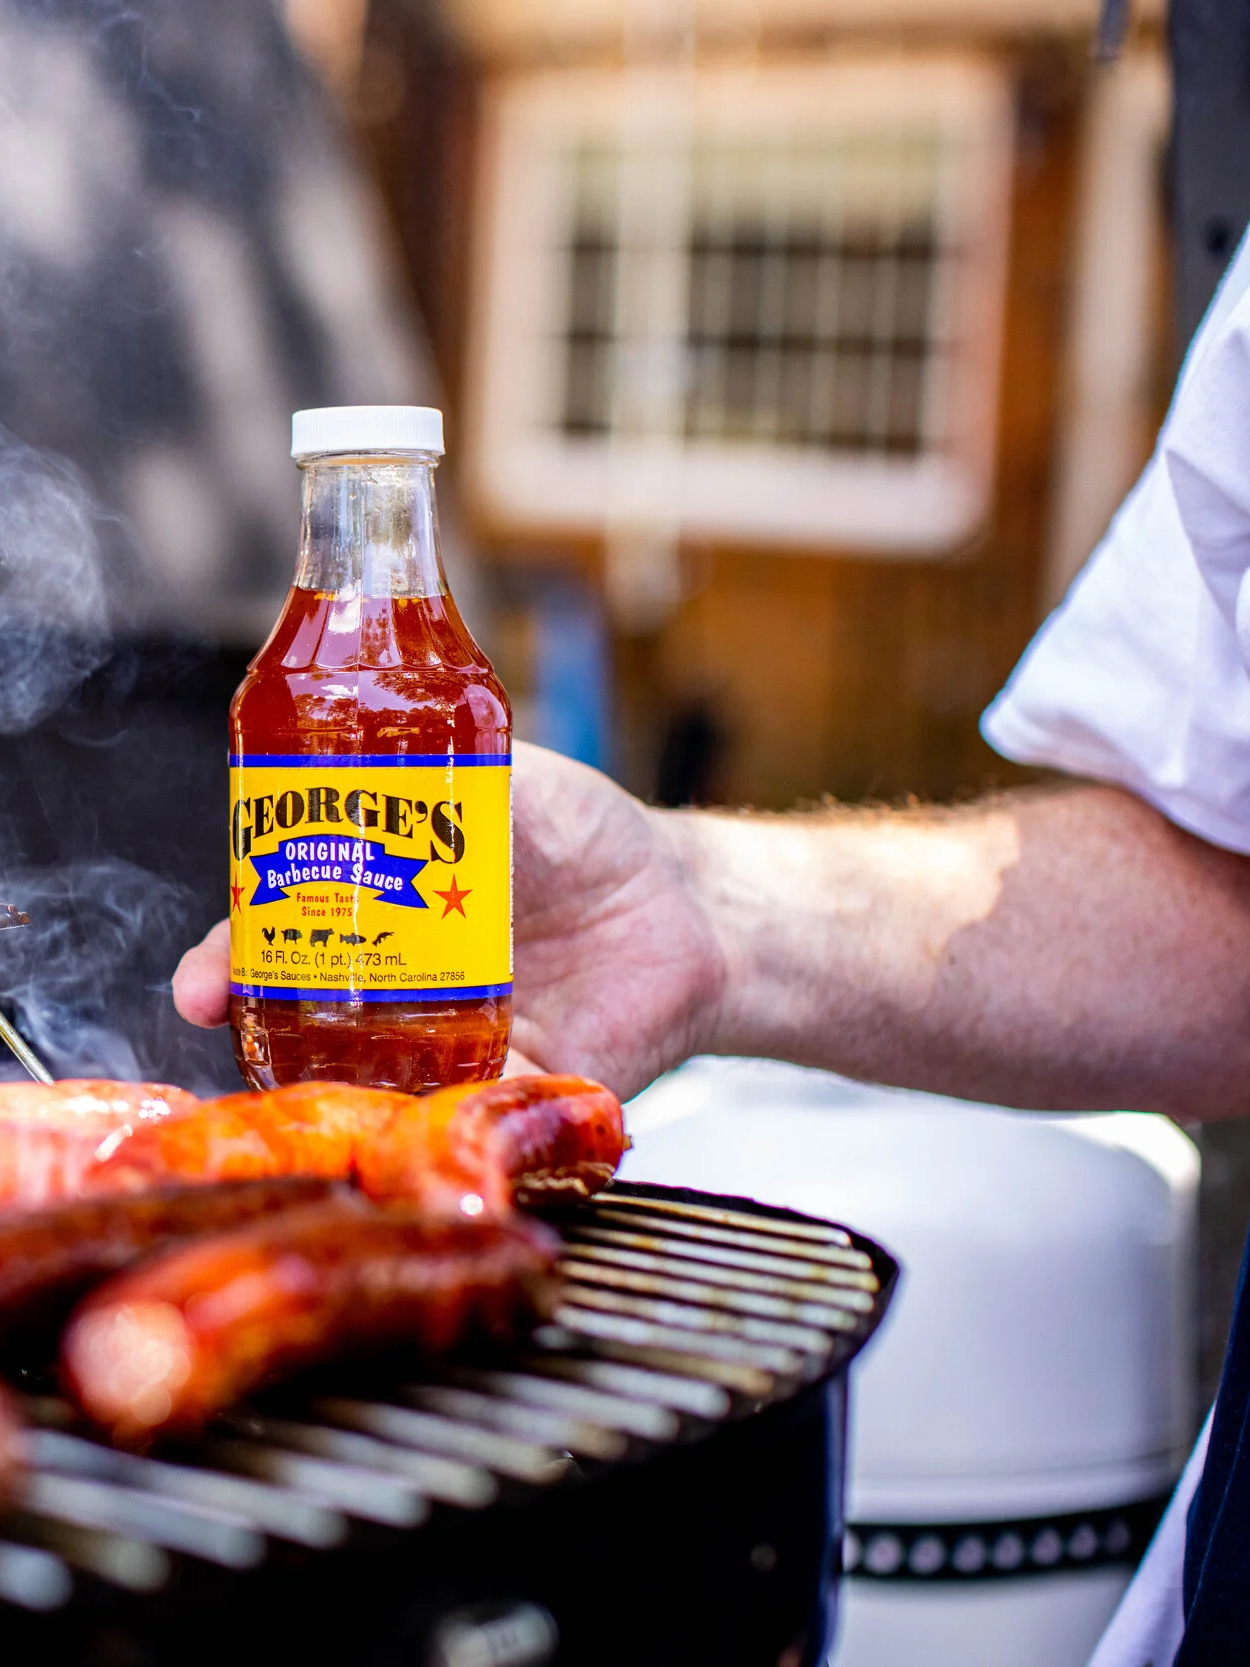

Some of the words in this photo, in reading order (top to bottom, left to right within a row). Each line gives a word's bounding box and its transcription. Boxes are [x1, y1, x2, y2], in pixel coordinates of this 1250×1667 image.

[232, 787, 465, 864] GEORGE'S
[285, 842, 375, 862] ORIGINAL
[267, 864, 342, 889] Barbecue
[350, 864, 403, 891] Sauce
[296, 892, 329, 903] Famous
[302, 906, 326, 917] Since
[331, 907, 352, 917] 1975
[261, 950, 273, 963] 16
[275, 950, 288, 964] Fl.
[290, 951, 310, 965] Oz.
[315, 952, 325, 968] (1
[331, 952, 352, 969] pt.)
[355, 953, 382, 966] 473
[385, 953, 406, 966] mL
[250, 968, 279, 981] George's
[280, 971, 311, 981] Sauces
[319, 972, 366, 983] Nashvlle,
[369, 973, 397, 982] North
[399, 972, 438, 982] Carolina
[439, 971, 465, 981] 27856
